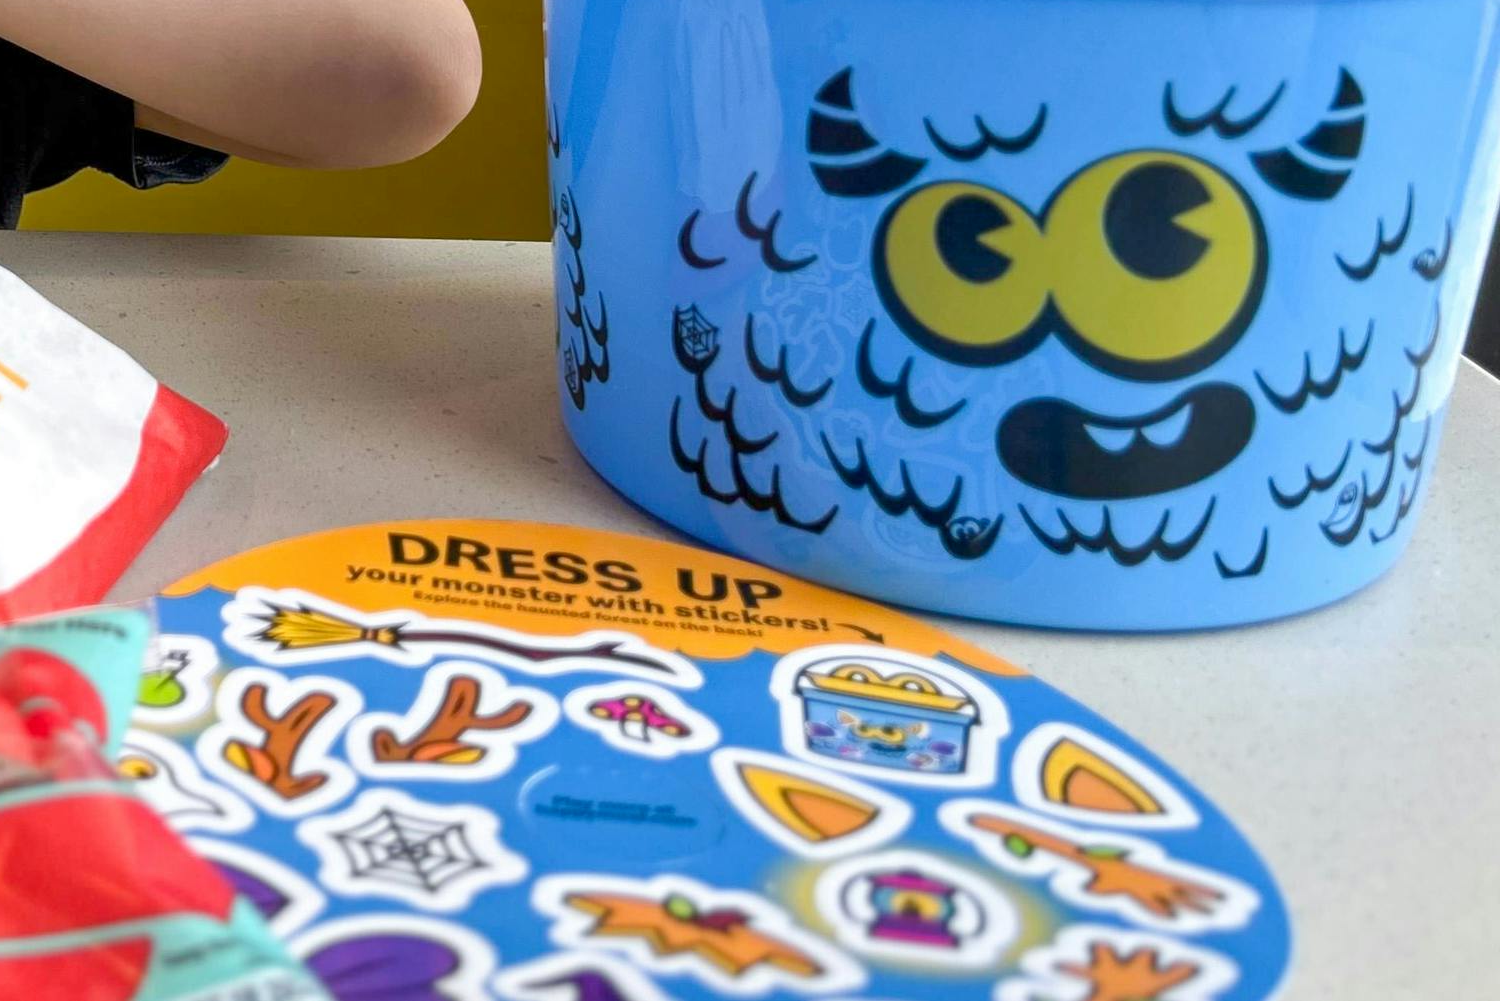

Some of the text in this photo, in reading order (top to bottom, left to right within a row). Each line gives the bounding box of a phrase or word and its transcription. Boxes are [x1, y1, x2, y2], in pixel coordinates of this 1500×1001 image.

[347, 564, 829, 632] your monster with stickers!
[388, 532, 782, 609] DRESS UP
[413, 590, 479, 606] Explore
[483, 599, 512, 611] the
[516, 602, 591, 620] haunted
[595, 611, 649, 626] forest
[653, 619, 676, 631] on
[679, 621, 710, 633] the
